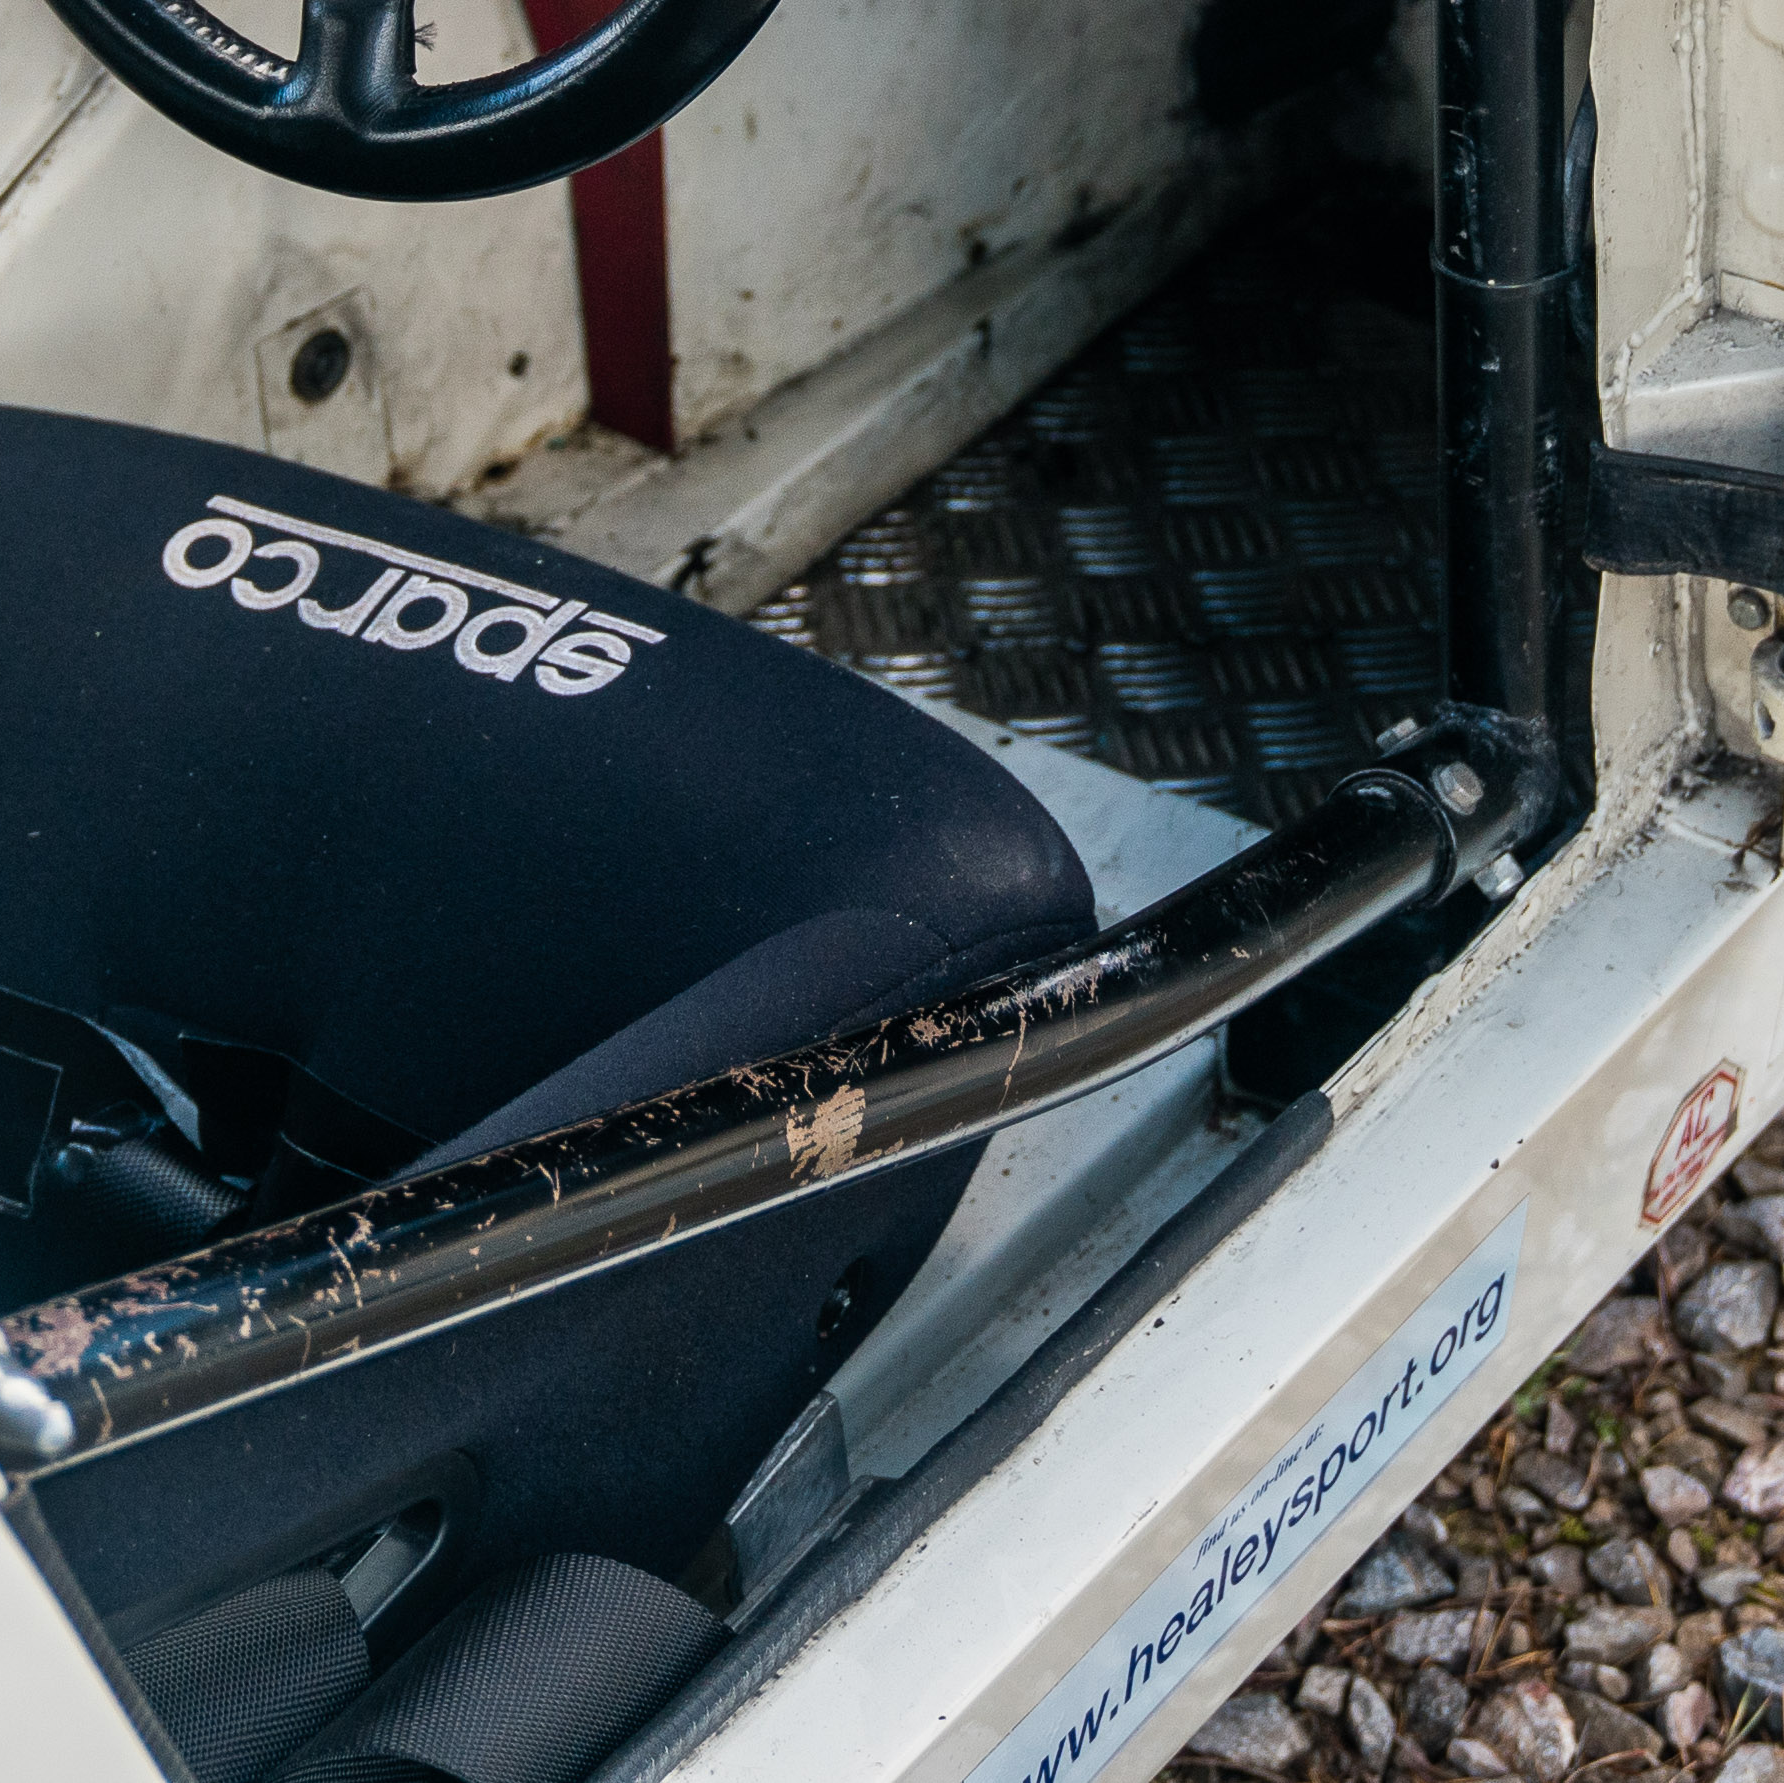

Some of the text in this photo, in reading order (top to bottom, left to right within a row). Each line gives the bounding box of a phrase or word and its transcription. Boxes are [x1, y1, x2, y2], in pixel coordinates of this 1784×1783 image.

[161, 494, 669, 697] sparco
[1193, 1516, 1230, 1570] find
[1230, 1499, 1248, 1524] us
[1250, 1445, 1304, 1505] on-line
